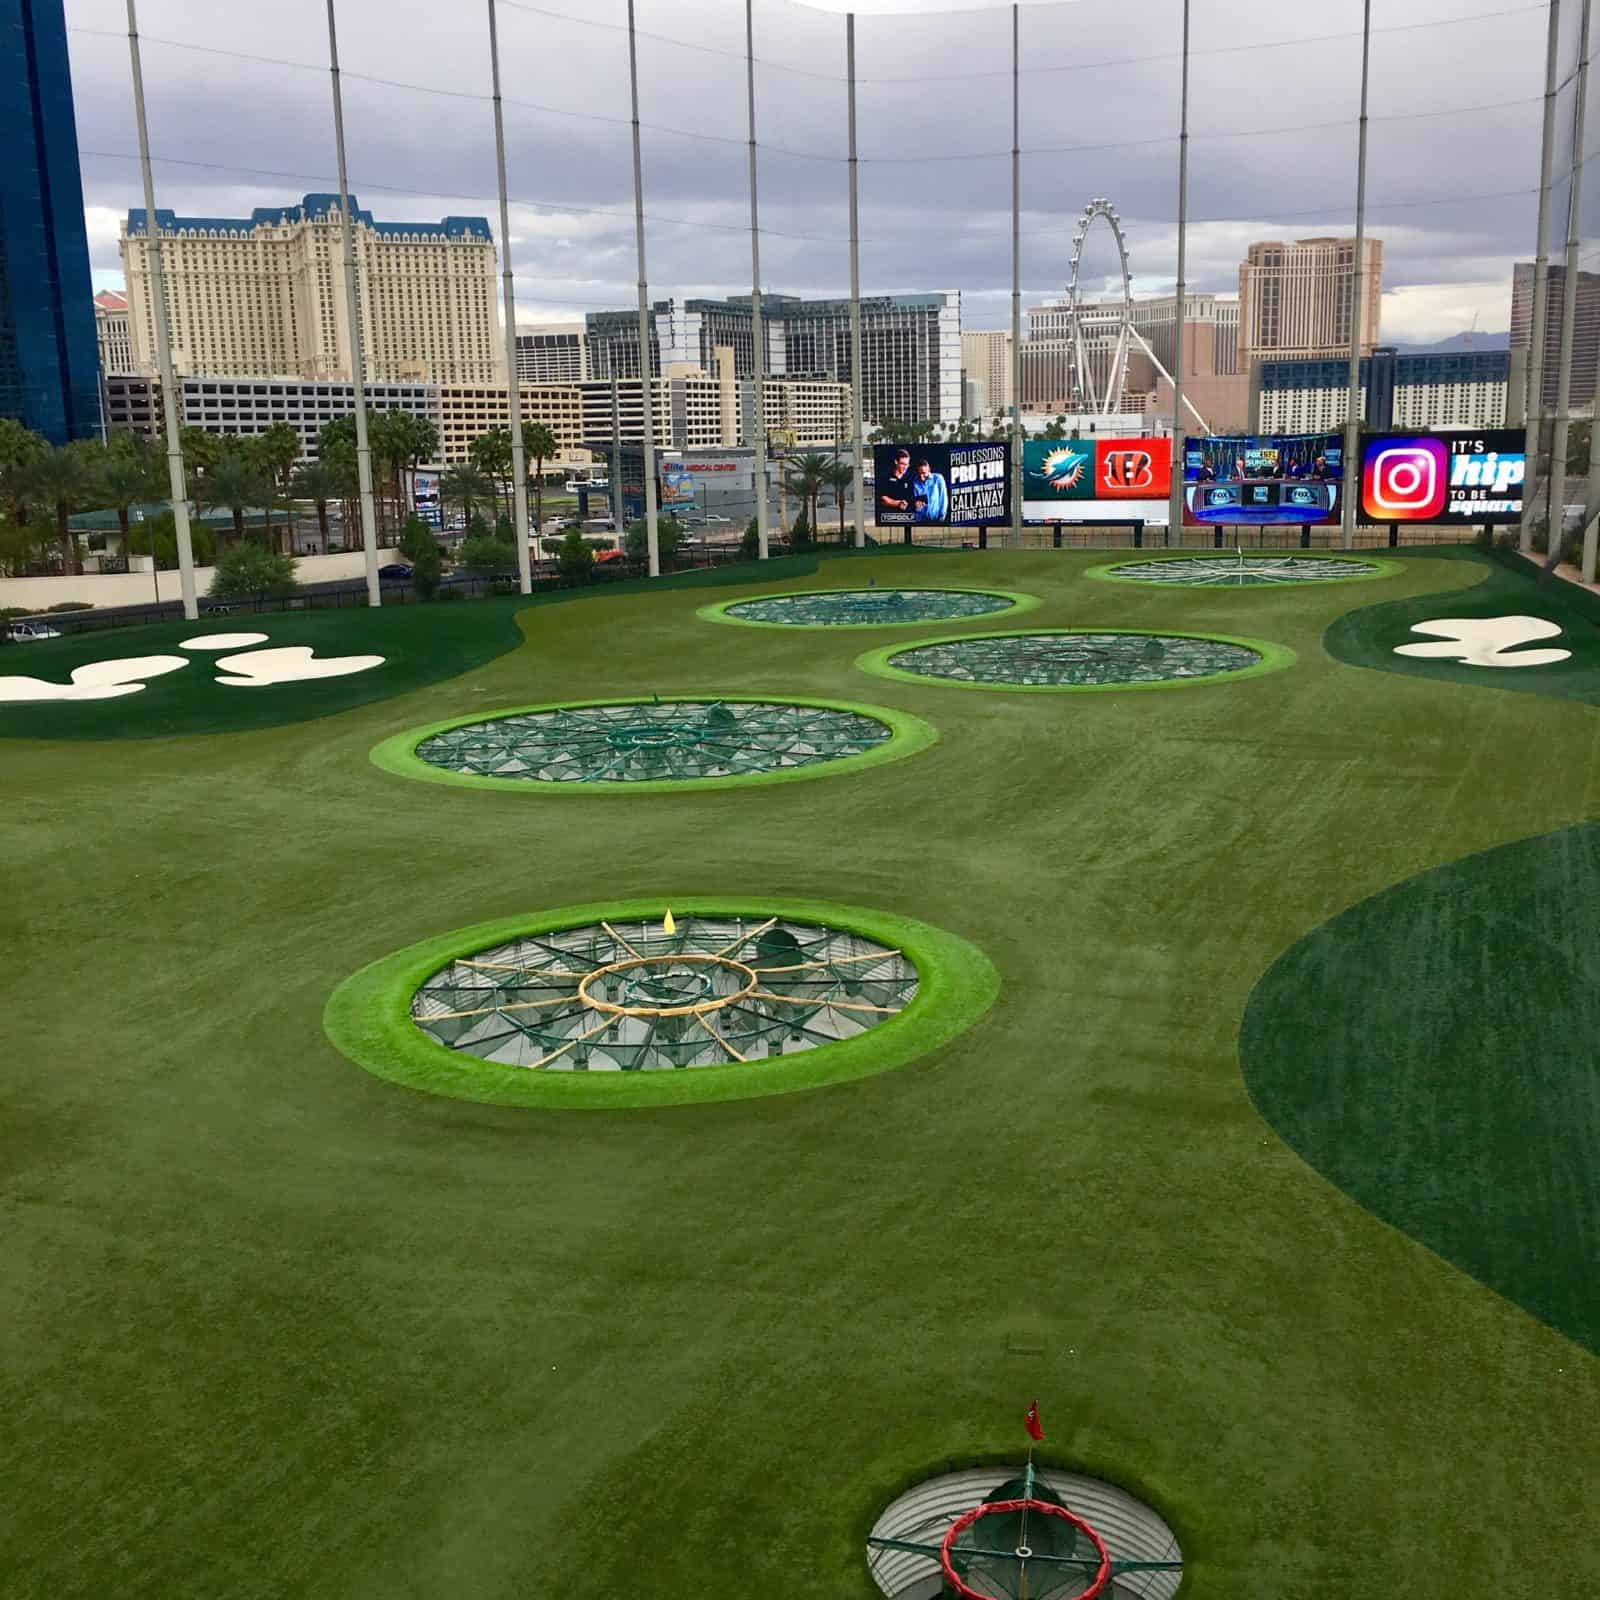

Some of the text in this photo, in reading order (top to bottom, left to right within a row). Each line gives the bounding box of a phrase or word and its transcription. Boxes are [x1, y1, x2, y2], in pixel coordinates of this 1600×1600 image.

[950, 446, 1005, 466] PRO LESSONS
[1452, 440, 1484, 453] IT'S
[950, 460, 1005, 485] PRO FUN
[1450, 452, 1526, 492] hip
[951, 488, 1005, 512] CALLAWAY
[1450, 490, 1487, 500] TO BE
[950, 505, 1005, 523] FITTING STUDIO
[1448, 500, 1523, 516] square
